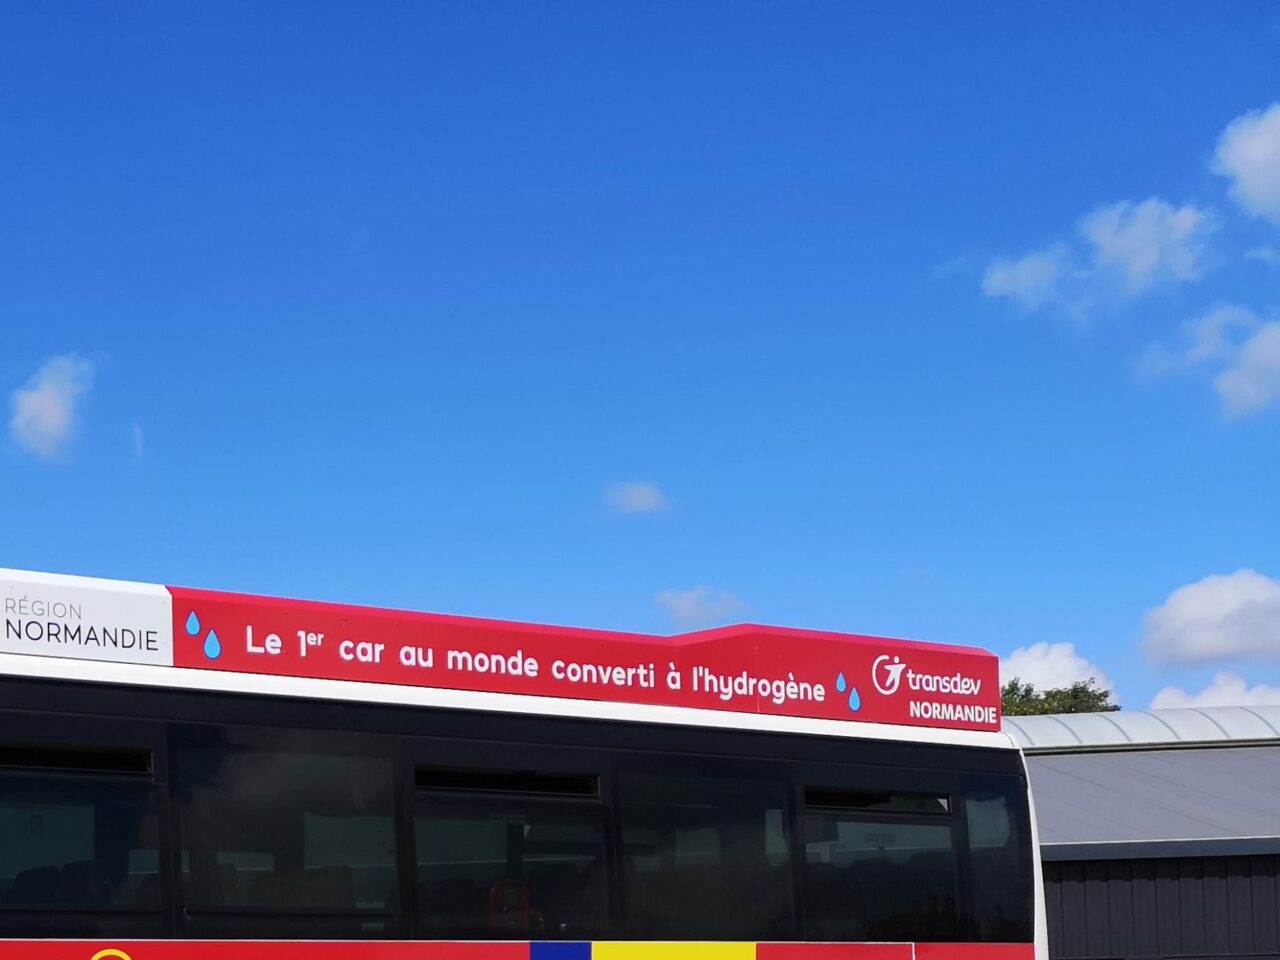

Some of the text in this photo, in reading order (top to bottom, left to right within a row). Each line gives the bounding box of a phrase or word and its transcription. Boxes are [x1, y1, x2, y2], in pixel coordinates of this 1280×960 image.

[5, 595, 82, 620] RÉGION
[5, 619, 159, 651] NORMANDIE
[245, 625, 825, 705] Le 1er car au monde converti à l'hydrogène
[906, 669, 982, 696] transdev
[909, 700, 998, 724] NORMANDIE
